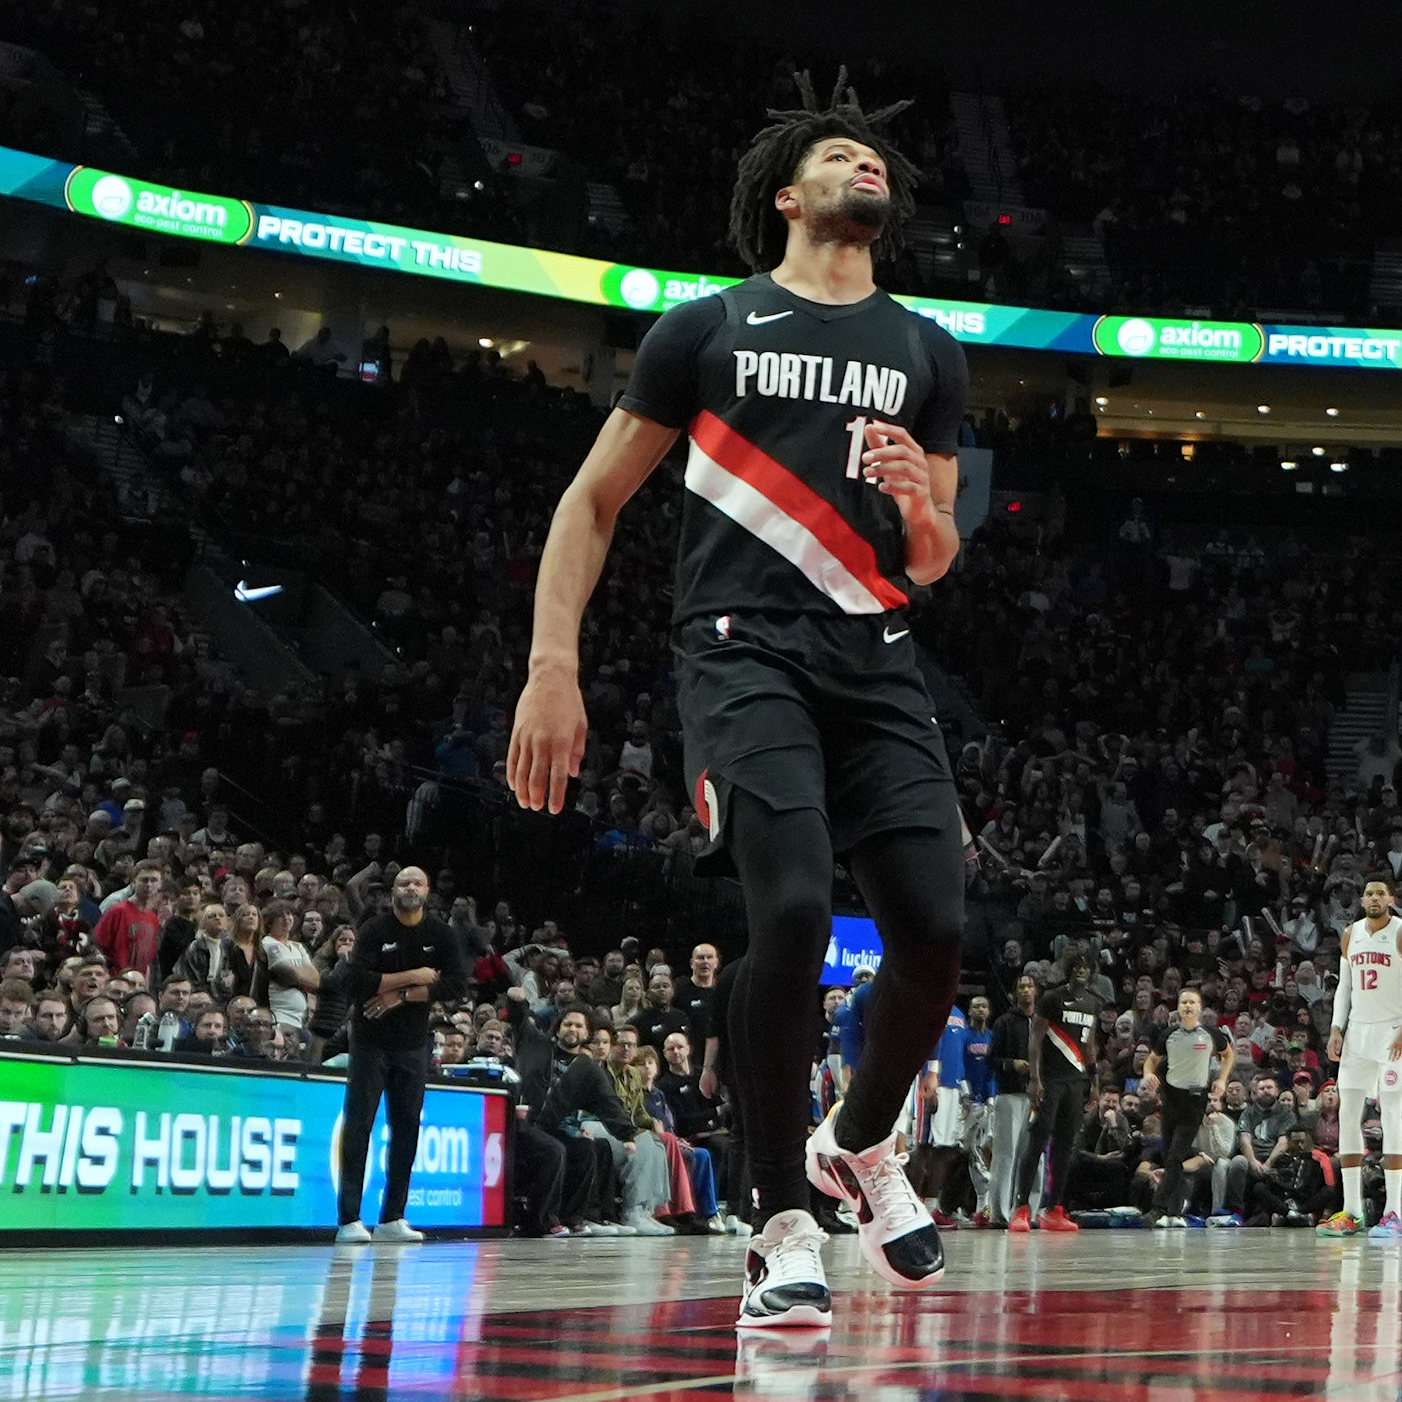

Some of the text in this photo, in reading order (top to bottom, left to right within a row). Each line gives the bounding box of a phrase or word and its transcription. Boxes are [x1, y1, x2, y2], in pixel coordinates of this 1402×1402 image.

[137, 190, 226, 225] axiom
[182, 222, 222, 238] control
[258, 215, 482, 273] PROTECT THIS
[664, 277, 728, 300] axi
[1160, 323, 1240, 347] axiom
[1204, 349, 1238, 358] control
[1269, 335, 1401, 360] PROTECT
[733, 350, 908, 416] PORTLAND
[841, 949, 882, 966] luckin
[1350, 952, 1392, 967] PISTONS
[1361, 970, 1377, 990] 12
[1062, 1011, 1094, 1026] PORTLAND
[0, 1102, 301, 1196] THIS HOUSE
[426, 1188, 462, 1206] control
